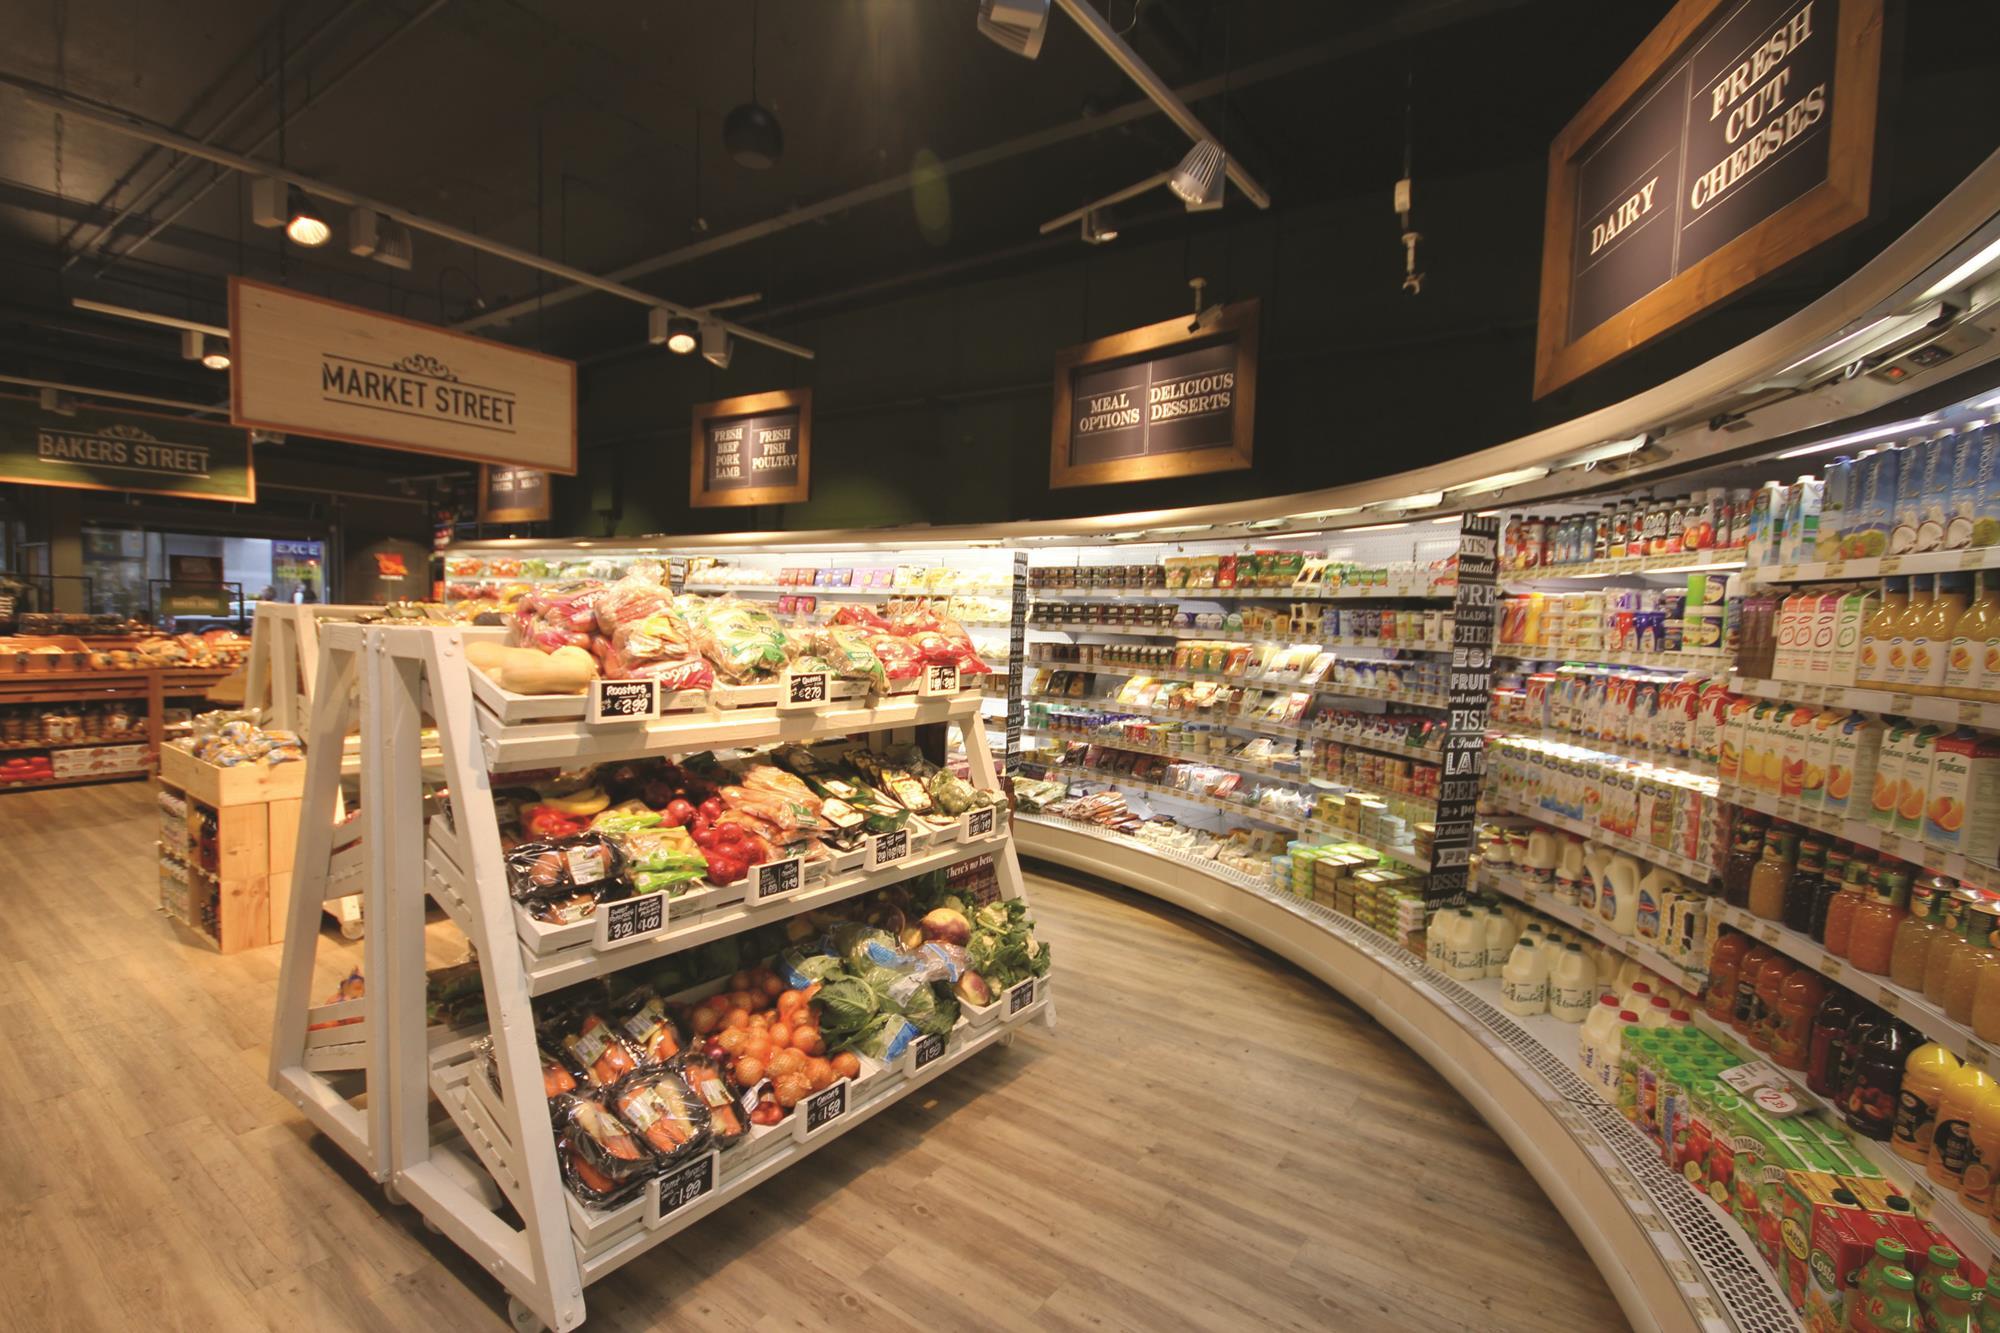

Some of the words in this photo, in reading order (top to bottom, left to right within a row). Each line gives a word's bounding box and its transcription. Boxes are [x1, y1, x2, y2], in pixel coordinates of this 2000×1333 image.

[1709, 0, 1815, 123] FRESH
[1725, 66, 1790, 145] CUT
[1691, 83, 1826, 211] CHEESES
[1590, 176, 1660, 256] DAIRY
[322, 362, 428, 408] MARKET
[435, 386, 516, 425] STREET
[1150, 372, 1234, 403] DELICIOUS
[1090, 393, 1130, 414] MEAL
[1150, 391, 1231, 420] DESSERTS
[1079, 408, 1141, 432] OPTIONS
[714, 427, 743, 443] FRESH
[759, 428, 791, 444] FRESH
[38, 433, 128, 464] BAKERS
[134, 445, 210, 473] STREET
[715, 453, 741, 466] PORK
[752, 454, 798, 470] POULTRY
[763, 442, 787, 456] FISH
[715, 466, 741, 479] LAMB
[606, 684, 647, 696] Roosters
[1811, 1252, 1836, 1284] Costa
